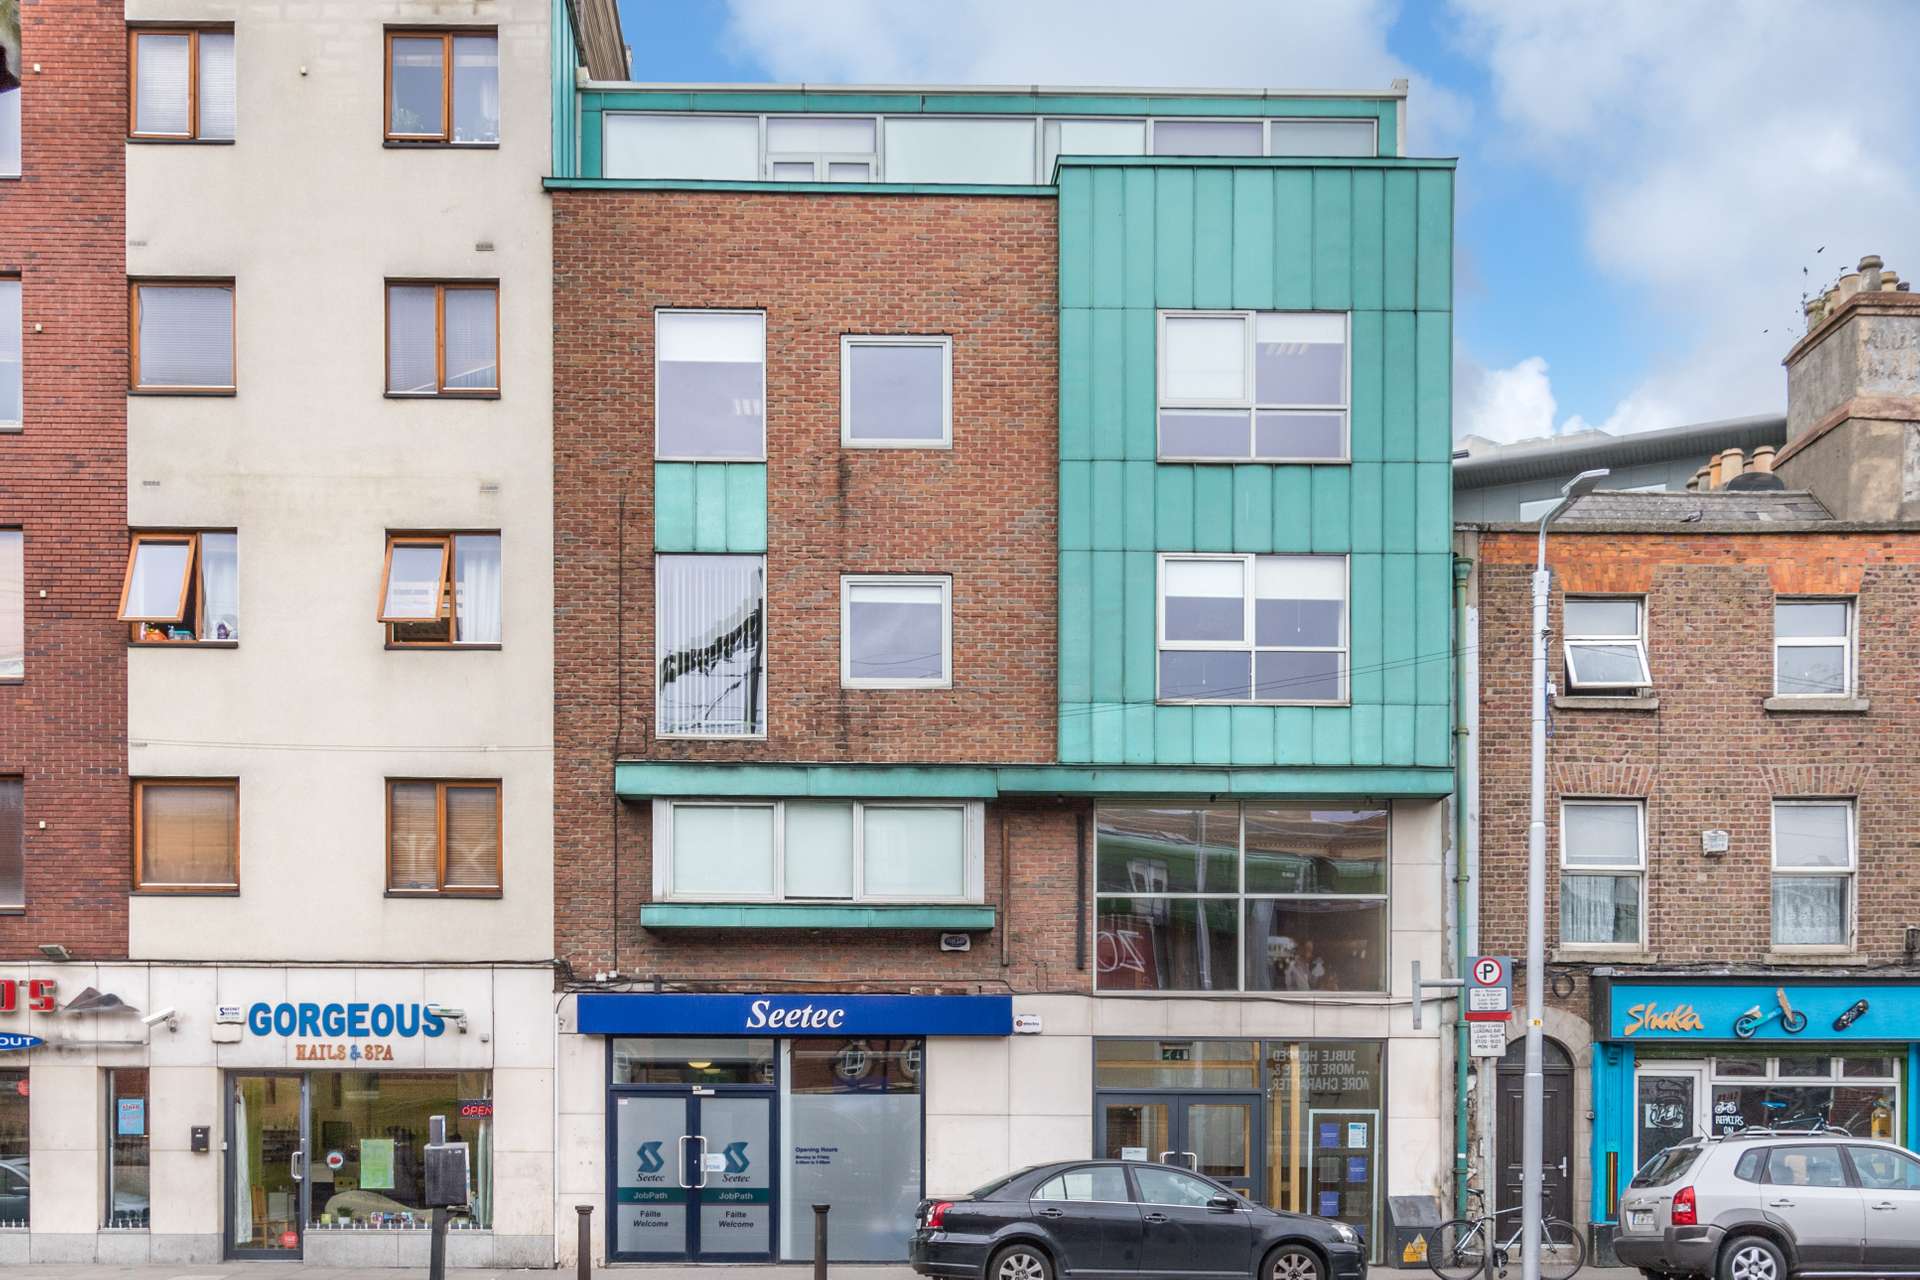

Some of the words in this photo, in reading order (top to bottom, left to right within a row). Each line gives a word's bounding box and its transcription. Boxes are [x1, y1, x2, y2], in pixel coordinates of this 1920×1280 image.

[1483, 963, 1494, 980] P
[249, 1002, 446, 1037] GORGEOUS
[746, 1000, 845, 1028] Seetec
[1623, 1002, 1704, 1036] Shaka
[296, 1044, 346, 1061] NAILS
[350, 1044, 363, 1061] &
[364, 1044, 394, 1061] SPA
[462, 1105, 493, 1116] OPEN
[1715, 1115, 1744, 1126] REPAIRS
[636, 1173, 665, 1182] Seetec
[722, 1173, 751, 1183] Seetec
[633, 1191, 668, 1199] JobPath
[719, 1192, 753, 1200] JobPath
[719, 1220, 754, 1228] Welcome
